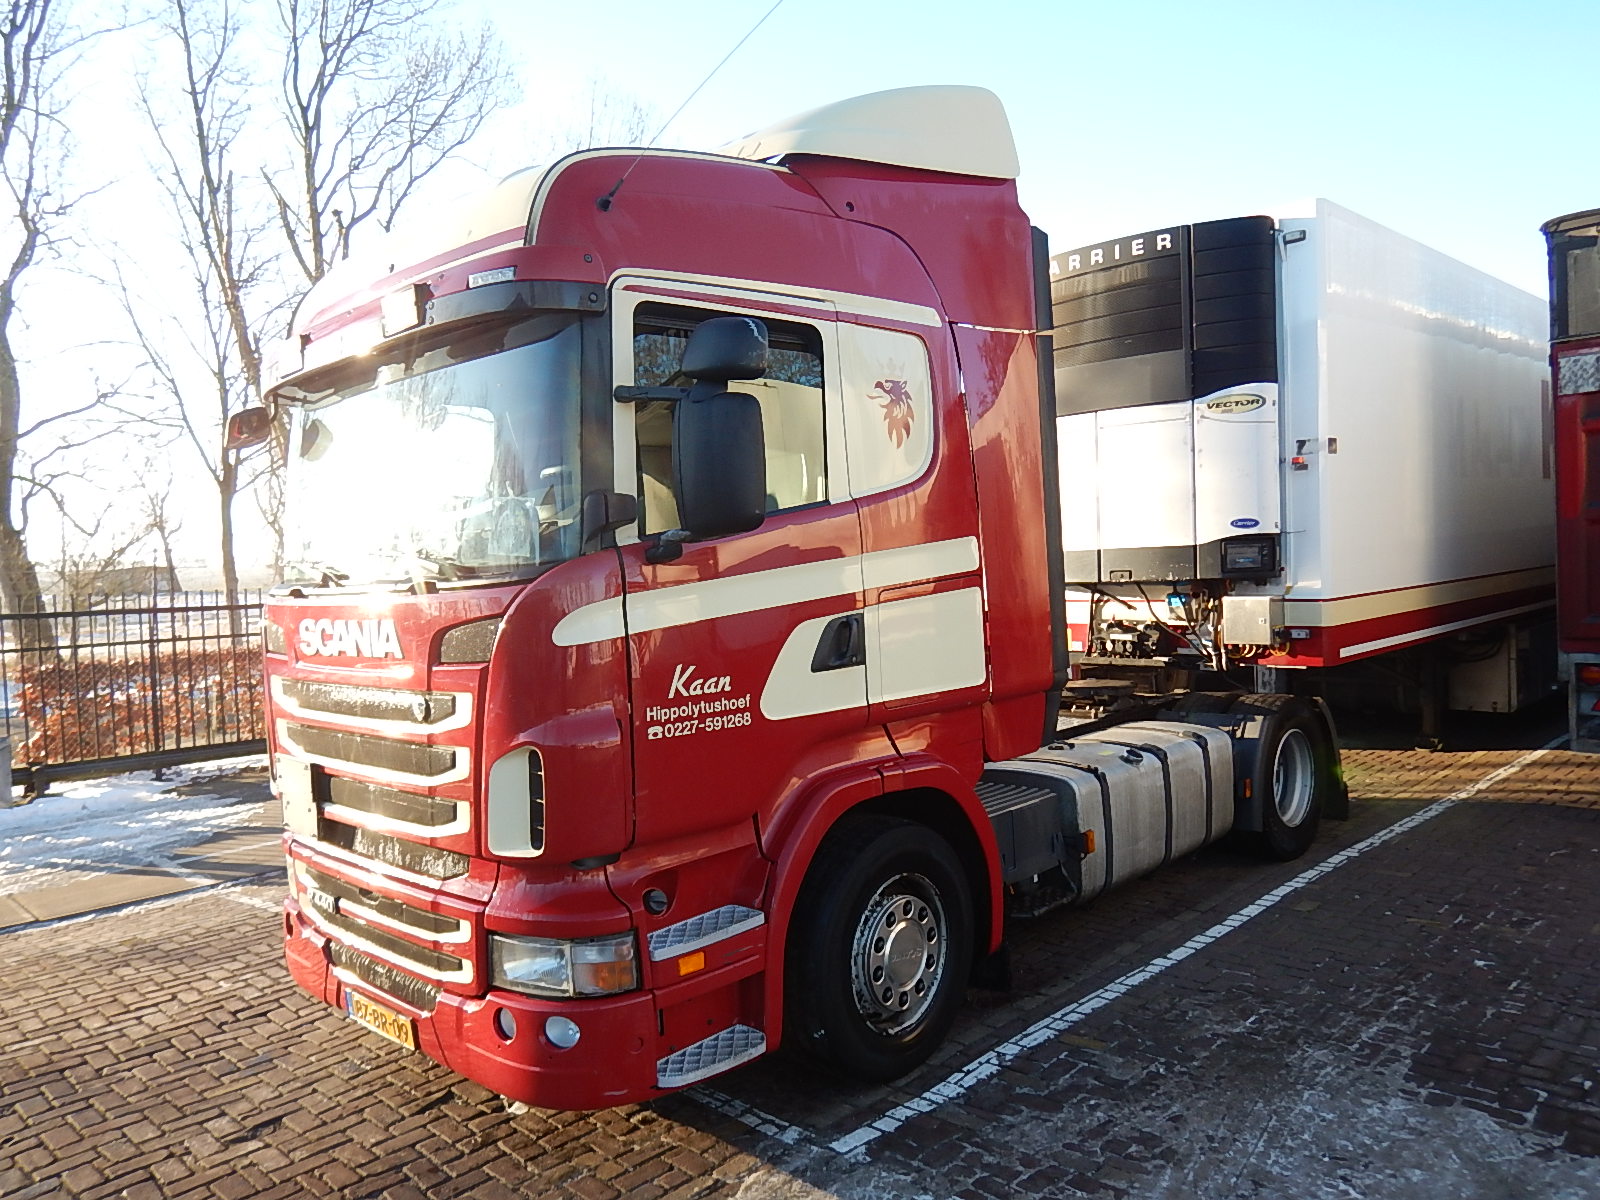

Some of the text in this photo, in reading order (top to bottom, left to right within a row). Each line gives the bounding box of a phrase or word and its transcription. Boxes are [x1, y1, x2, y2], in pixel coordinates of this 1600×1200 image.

[1049, 233, 1172, 275] ARRIER
[1207, 399, 1260, 409] VECTOR
[298, 618, 405, 659] SCANIA
[668, 664, 731, 699] Kaan
[646, 694, 750, 722] Hippolytushoef
[664, 712, 752, 737] 0227-591268
